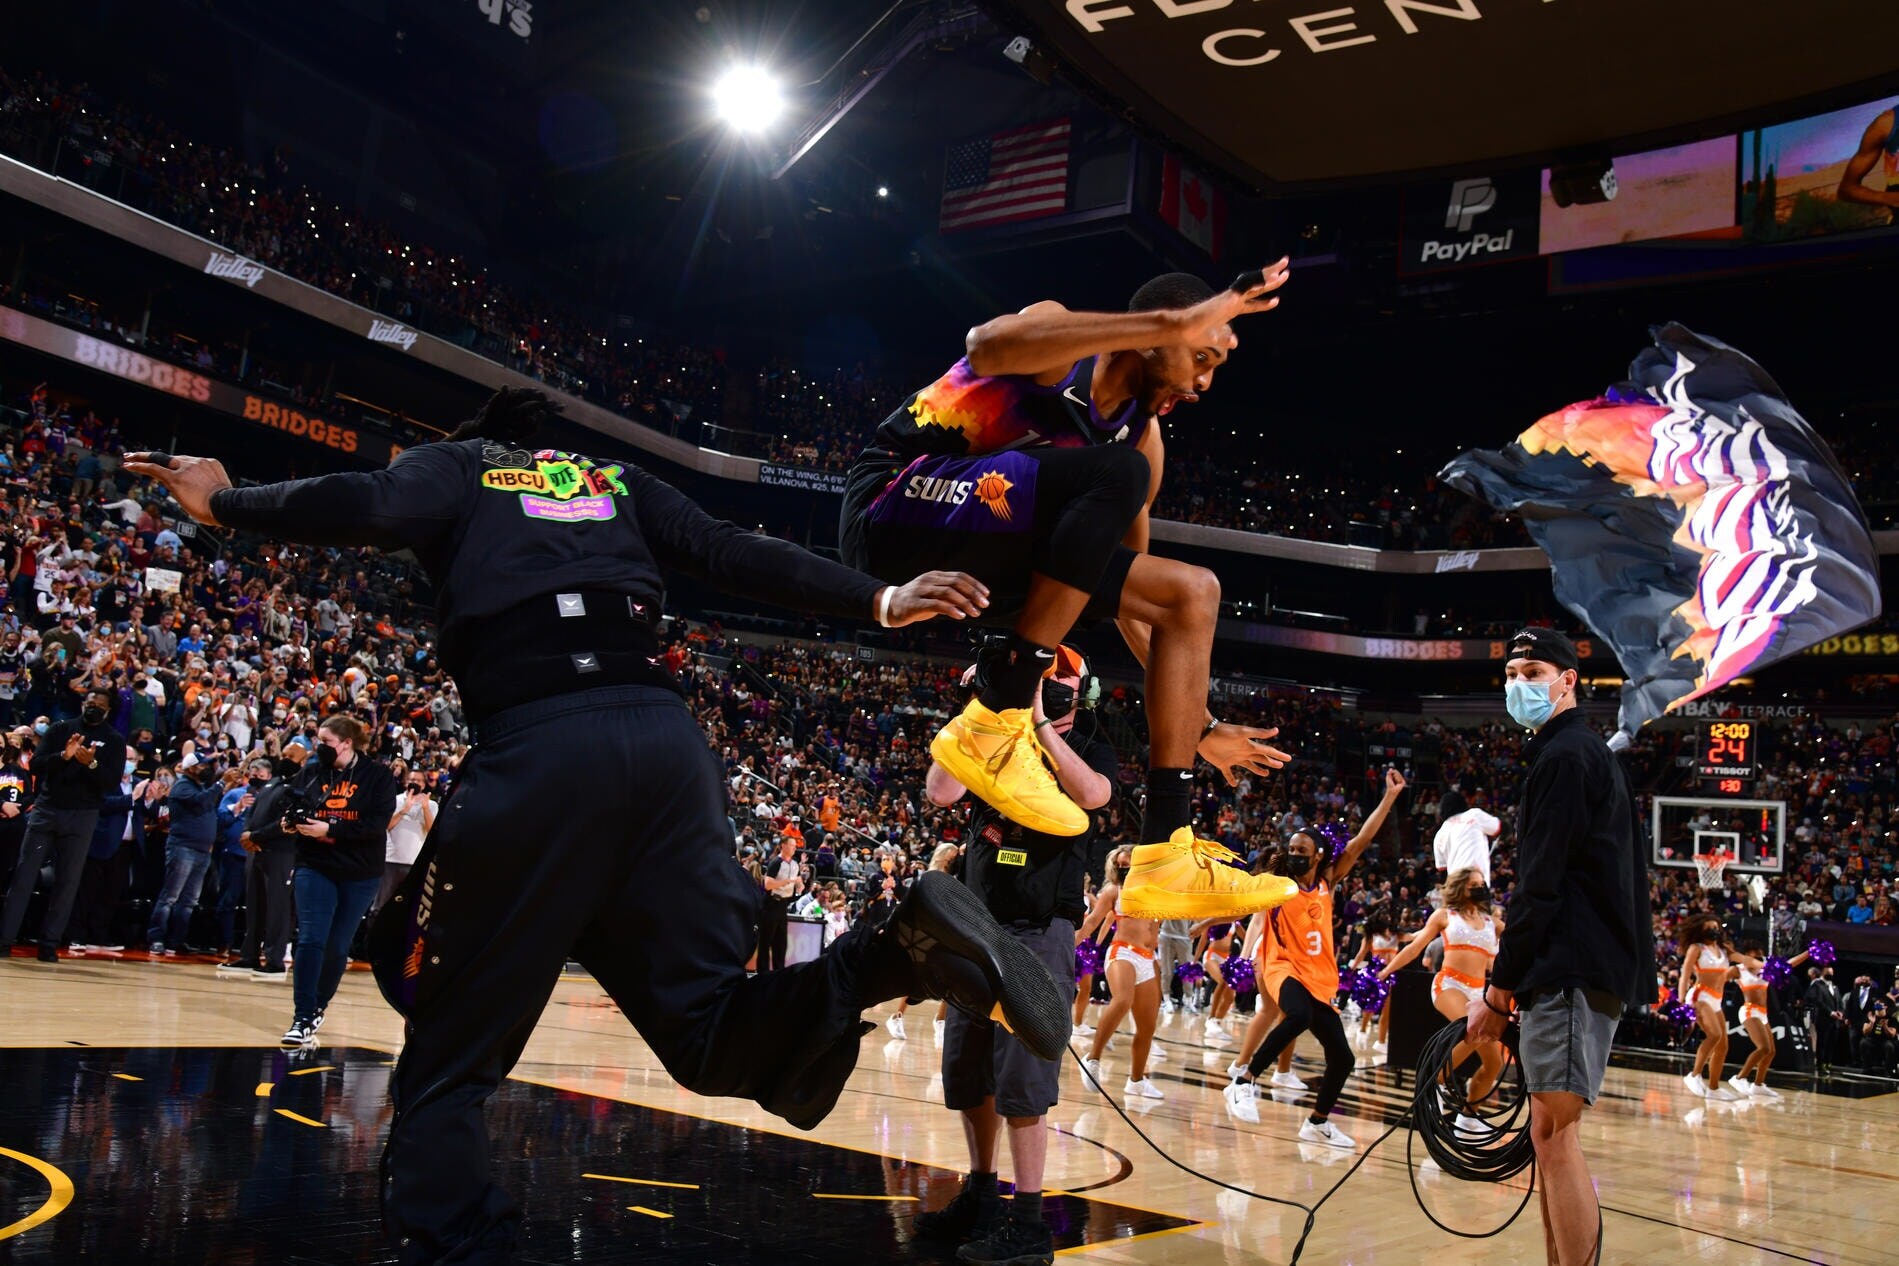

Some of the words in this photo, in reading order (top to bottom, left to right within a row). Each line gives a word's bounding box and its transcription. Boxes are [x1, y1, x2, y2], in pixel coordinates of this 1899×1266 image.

[1202, 0, 1484, 67] CEN
[1421, 229, 1513, 262] PayPal
[204, 252, 264, 288] Valley
[367, 320, 418, 351] Valley
[75, 334, 210, 402] BRIDGES
[243, 394, 358, 452] BRIDGES
[488, 472, 545, 490] HBCU
[761, 466, 775, 475] ON
[777, 467, 794, 478] THE
[1365, 636, 1462, 659] BRIDGES
[1710, 723, 1750, 739] 12:00
[1708, 738, 1745, 763] 24
[9, 788, 18, 802] 3
[1001, 852, 1023, 864] OFFICIAL
[1306, 931, 1322, 956] 3
